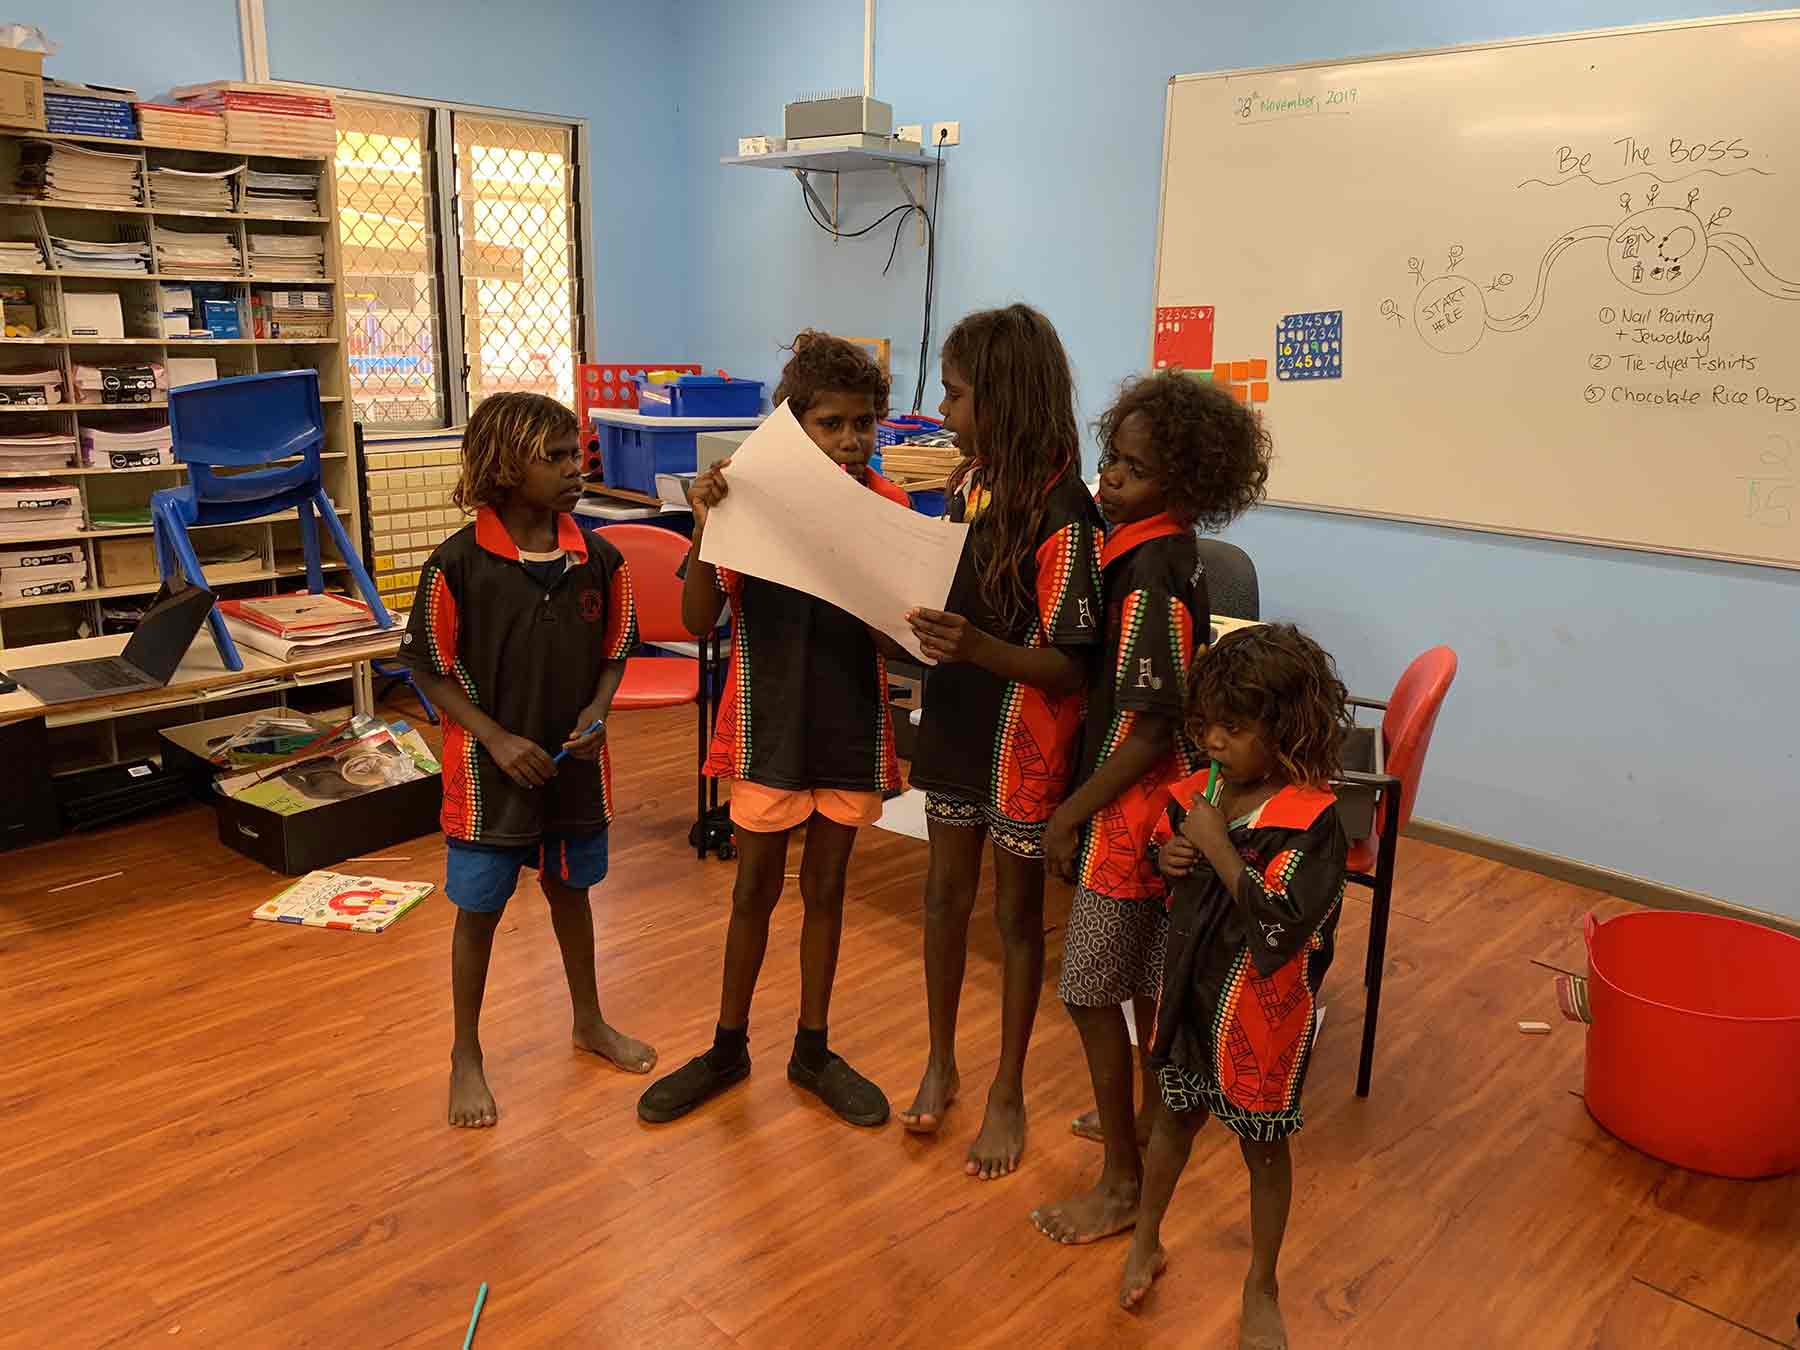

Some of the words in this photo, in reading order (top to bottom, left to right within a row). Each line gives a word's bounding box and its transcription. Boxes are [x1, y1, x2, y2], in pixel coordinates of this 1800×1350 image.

[1325, 87, 1360, 105] 2019
[1557, 145, 1593, 174] Be
[1613, 136, 1656, 166] The
[1669, 137, 1749, 164] BOSS
[1422, 286, 1466, 321] START
[1431, 307, 1463, 334] HERE
[1622, 309, 1650, 323] Nail
[1658, 308, 1714, 333] Painting
[1689, 354, 1759, 372] T-shirts
[1611, 386, 1700, 405] Chocolate
[1712, 384, 1749, 405] Rice
[1756, 386, 1796, 412] Pops
